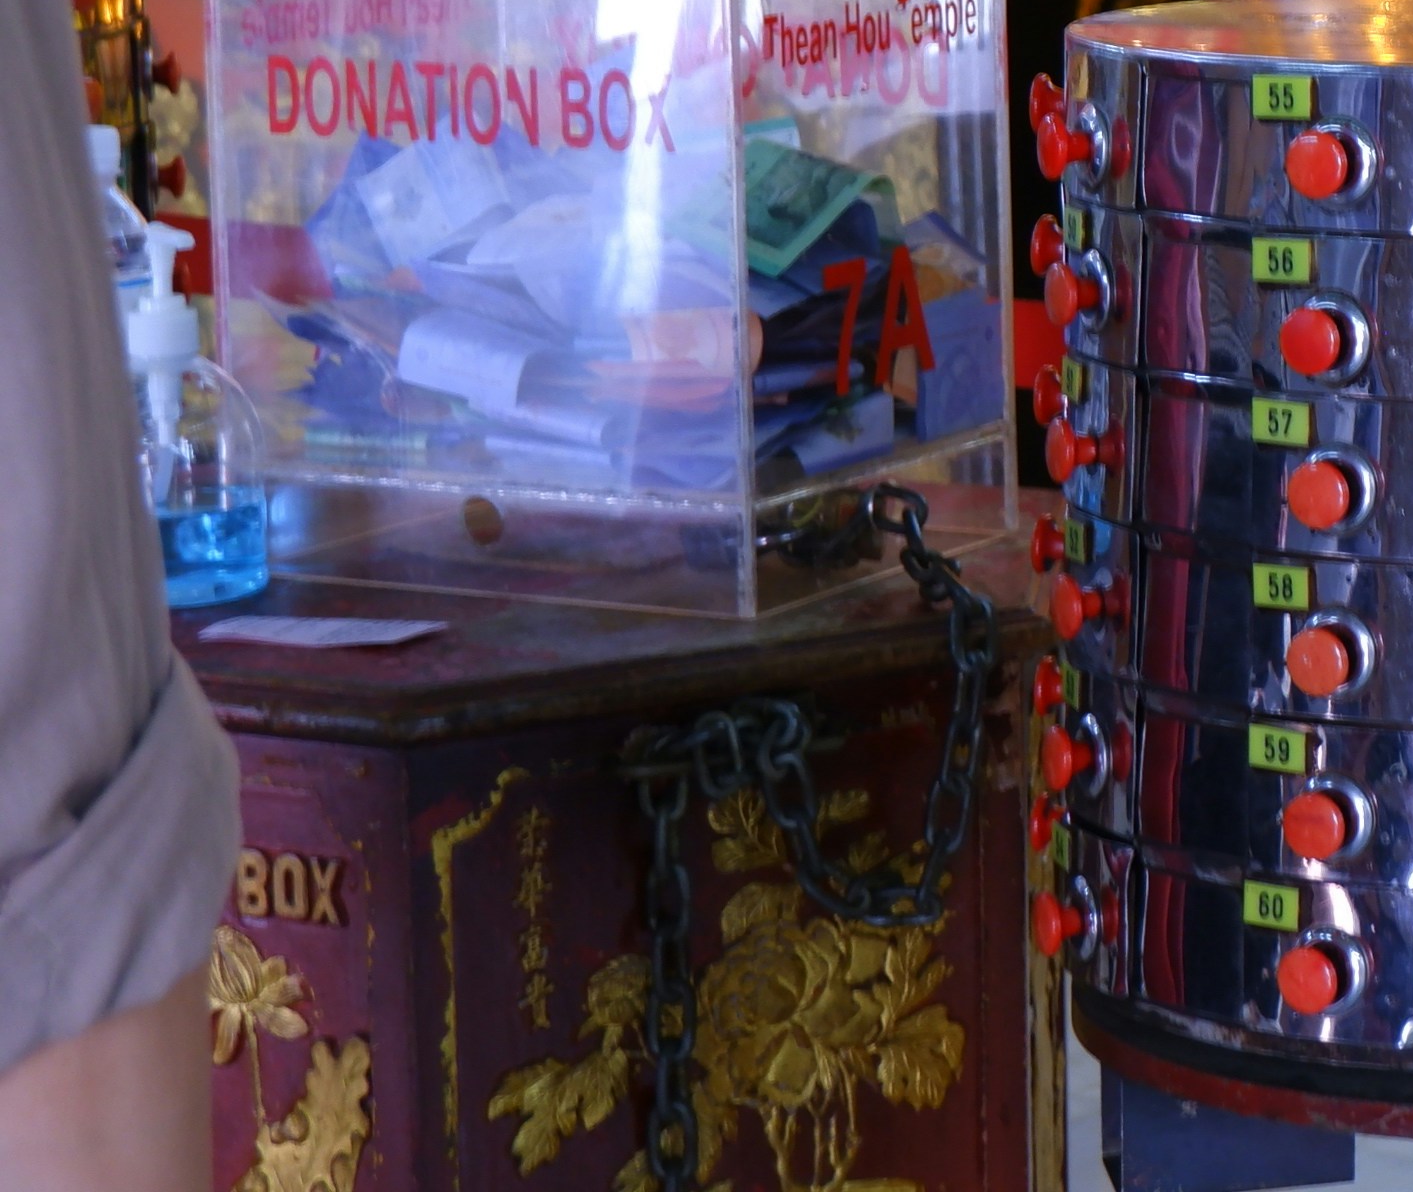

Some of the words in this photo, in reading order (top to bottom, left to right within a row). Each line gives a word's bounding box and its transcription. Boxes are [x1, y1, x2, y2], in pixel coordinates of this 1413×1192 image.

[764, 12, 838, 68] Thean
[844, 0, 892, 56] Hou
[267, 55, 540, 148] DONATION
[560, 67, 676, 152] BOX
[1269, 84, 1294, 111] 55
[1268, 248, 1293, 274] 56
[822, 245, 937, 396] 7A
[1268, 408, 1292, 435] 57
[1268, 573, 1293, 600] 58
[1264, 736, 1290, 763] 59
[236, 848, 340, 925] BOX
[1258, 893, 1284, 920] 60
